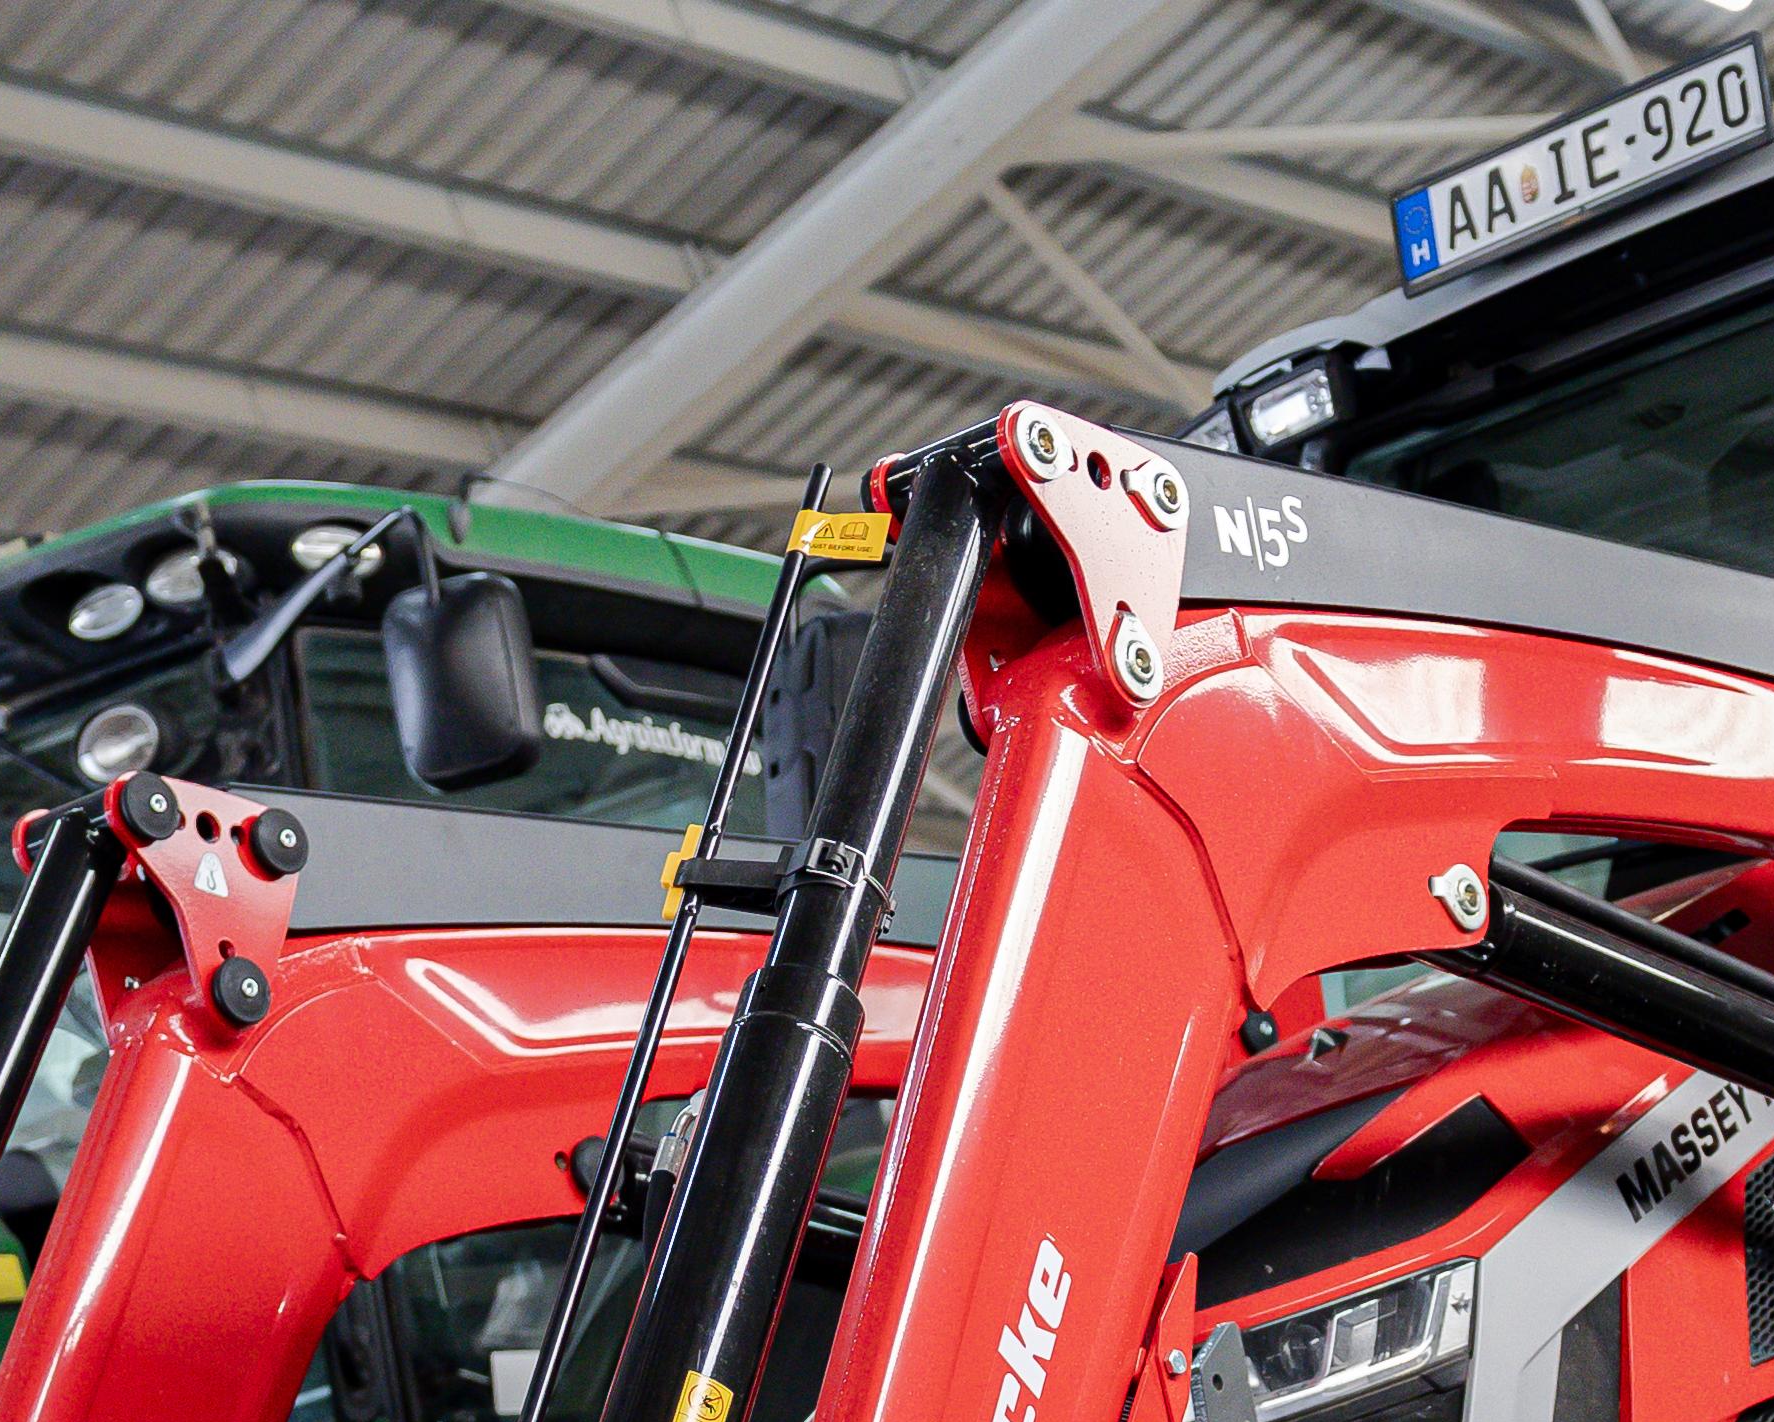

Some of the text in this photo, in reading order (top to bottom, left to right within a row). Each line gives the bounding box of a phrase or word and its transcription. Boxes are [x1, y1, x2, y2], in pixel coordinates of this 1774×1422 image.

[1410, 238, 1430, 266] H
[1449, 166, 1516, 250] AA
[828, 543, 855, 551] BEFORE
[1615, 1082, 1752, 1224] MASSEY
